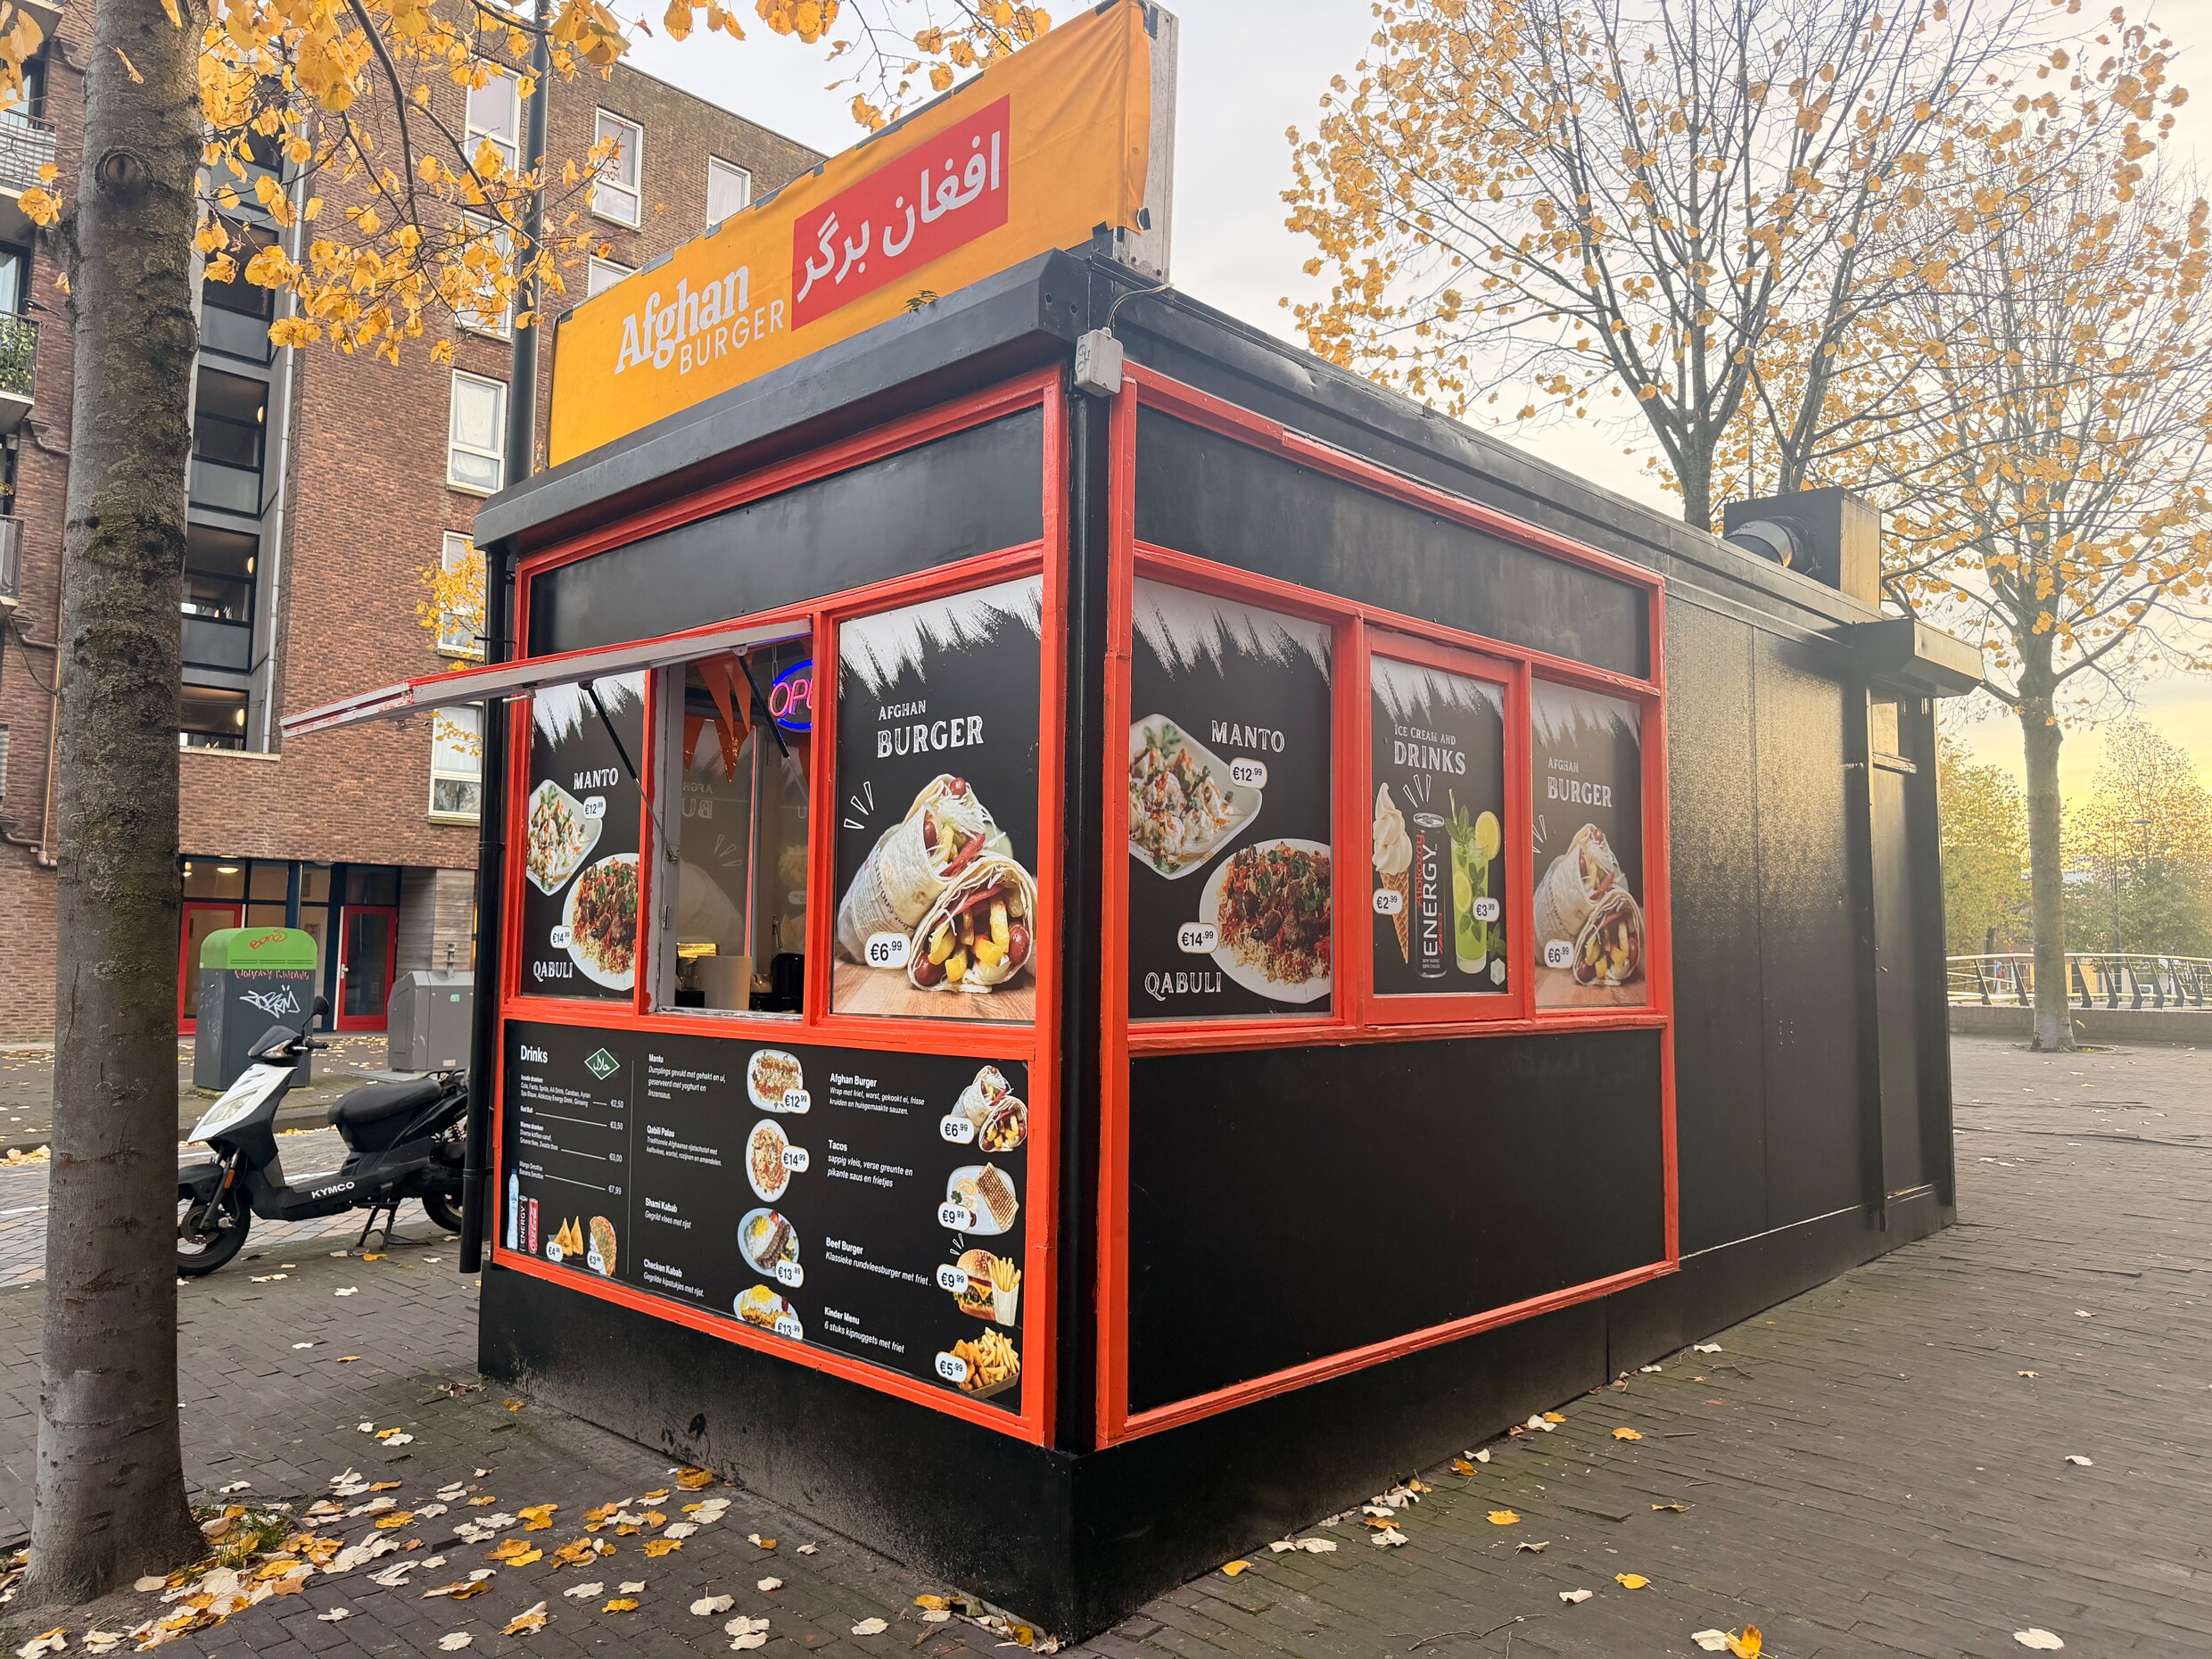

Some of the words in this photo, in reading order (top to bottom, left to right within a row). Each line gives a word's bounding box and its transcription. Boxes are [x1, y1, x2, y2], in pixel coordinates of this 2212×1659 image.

[882, 130, 1001, 257] افغان
[797, 211, 871, 302] برگر
[615, 266, 749, 375] Afghan
[680, 300, 784, 376] BURGER
[879, 700, 927, 721] AFGHAN
[878, 715, 984, 758] BURGER
[1211, 720, 1284, 753] MANTO
[1411, 728, 1438, 742] CREAM
[1440, 733, 1456, 746] AND
[1394, 740, 1466, 775] DRINKS
[1548, 757, 1579, 772] AFGHAN
[574, 767, 619, 790] MANTO
[1233, 766, 1262, 782] €12.99
[1548, 777, 1613, 808] BURGER
[585, 801, 604, 816] €12.99
[1376, 896, 1398, 910] €2.99
[1423, 844, 1438, 956] ENERGY
[1477, 904, 1495, 917] €3.99
[552, 932, 570, 945] €14.99
[1181, 931, 1214, 947] €14.99
[871, 940, 903, 962] €6.99
[1548, 947, 1570, 963] €6.99
[533, 962, 574, 983] QABULI
[1144, 971, 1222, 1001] QABULI
[521, 1045, 549, 1063] Drinks
[648, 1065, 671, 1077] Dumplings
[696, 1072, 712, 1080] gehakt
[830, 1072, 853, 1085] Afghan
[854, 1076, 877, 1089] Burger
[648, 1079, 673, 1087] geserveerd
[681, 1083, 699, 1092] yoghurt
[785, 1094, 807, 1108] €12.99
[830, 1086, 843, 1096] Wrap
[853, 1090, 864, 1099] friet,
[865, 1093, 880, 1101] worst,
[881, 1094, 902, 1102] gekookt
[910, 1096, 925, 1105] frisse
[830, 1098, 847, 1107] kruiden
[854, 1101, 888, 1112] huisgemaakte
[889, 1107, 909, 1115] sauzen.
[945, 1123, 968, 1137] €6.99
[828, 1139, 847, 1151] Tacos
[783, 1152, 805, 1166] €14.99
[828, 1155, 846, 1167] sappig
[863, 1161, 879, 1170] verse
[904, 1168, 913, 1176] en
[827, 1168, 849, 1179] pikante
[849, 1173, 863, 1182] saus
[872, 1175, 894, 1188] frietjes
[312, 1181, 355, 1199] KYMCO
[645, 1197, 661, 1209] Shami
[661, 1201, 678, 1213] Kabab
[645, 1210, 661, 1221] Gegrild
[661, 1215, 673, 1224] vlees
[673, 1218, 682, 1226] met
[682, 1220, 691, 1229] rijst
[943, 1209, 964, 1224] €9.99
[826, 1236, 841, 1250] Beef
[841, 1240, 863, 1255] Burger
[665, 1265, 682, 1277] Kabab
[779, 1267, 800, 1280] €13.99
[825, 1250, 853, 1266] Klassieke
[853, 1259, 902, 1278] rundvleesburger
[902, 1272, 914, 1282] met
[643, 1271, 662, 1283] Gegrilde
[684, 1285, 694, 1293] met
[941, 1272, 964, 1288] €9.99
[824, 1306, 843, 1319] Kinder
[843, 1312, 860, 1325] Menu
[824, 1321, 830, 1330] 6
[830, 1324, 846, 1334] stuks
[846, 1327, 878, 1345] kipnuggets
[879, 1339, 891, 1349] met
[891, 1341, 904, 1353] friet
[940, 1360, 963, 1376] €5.99
